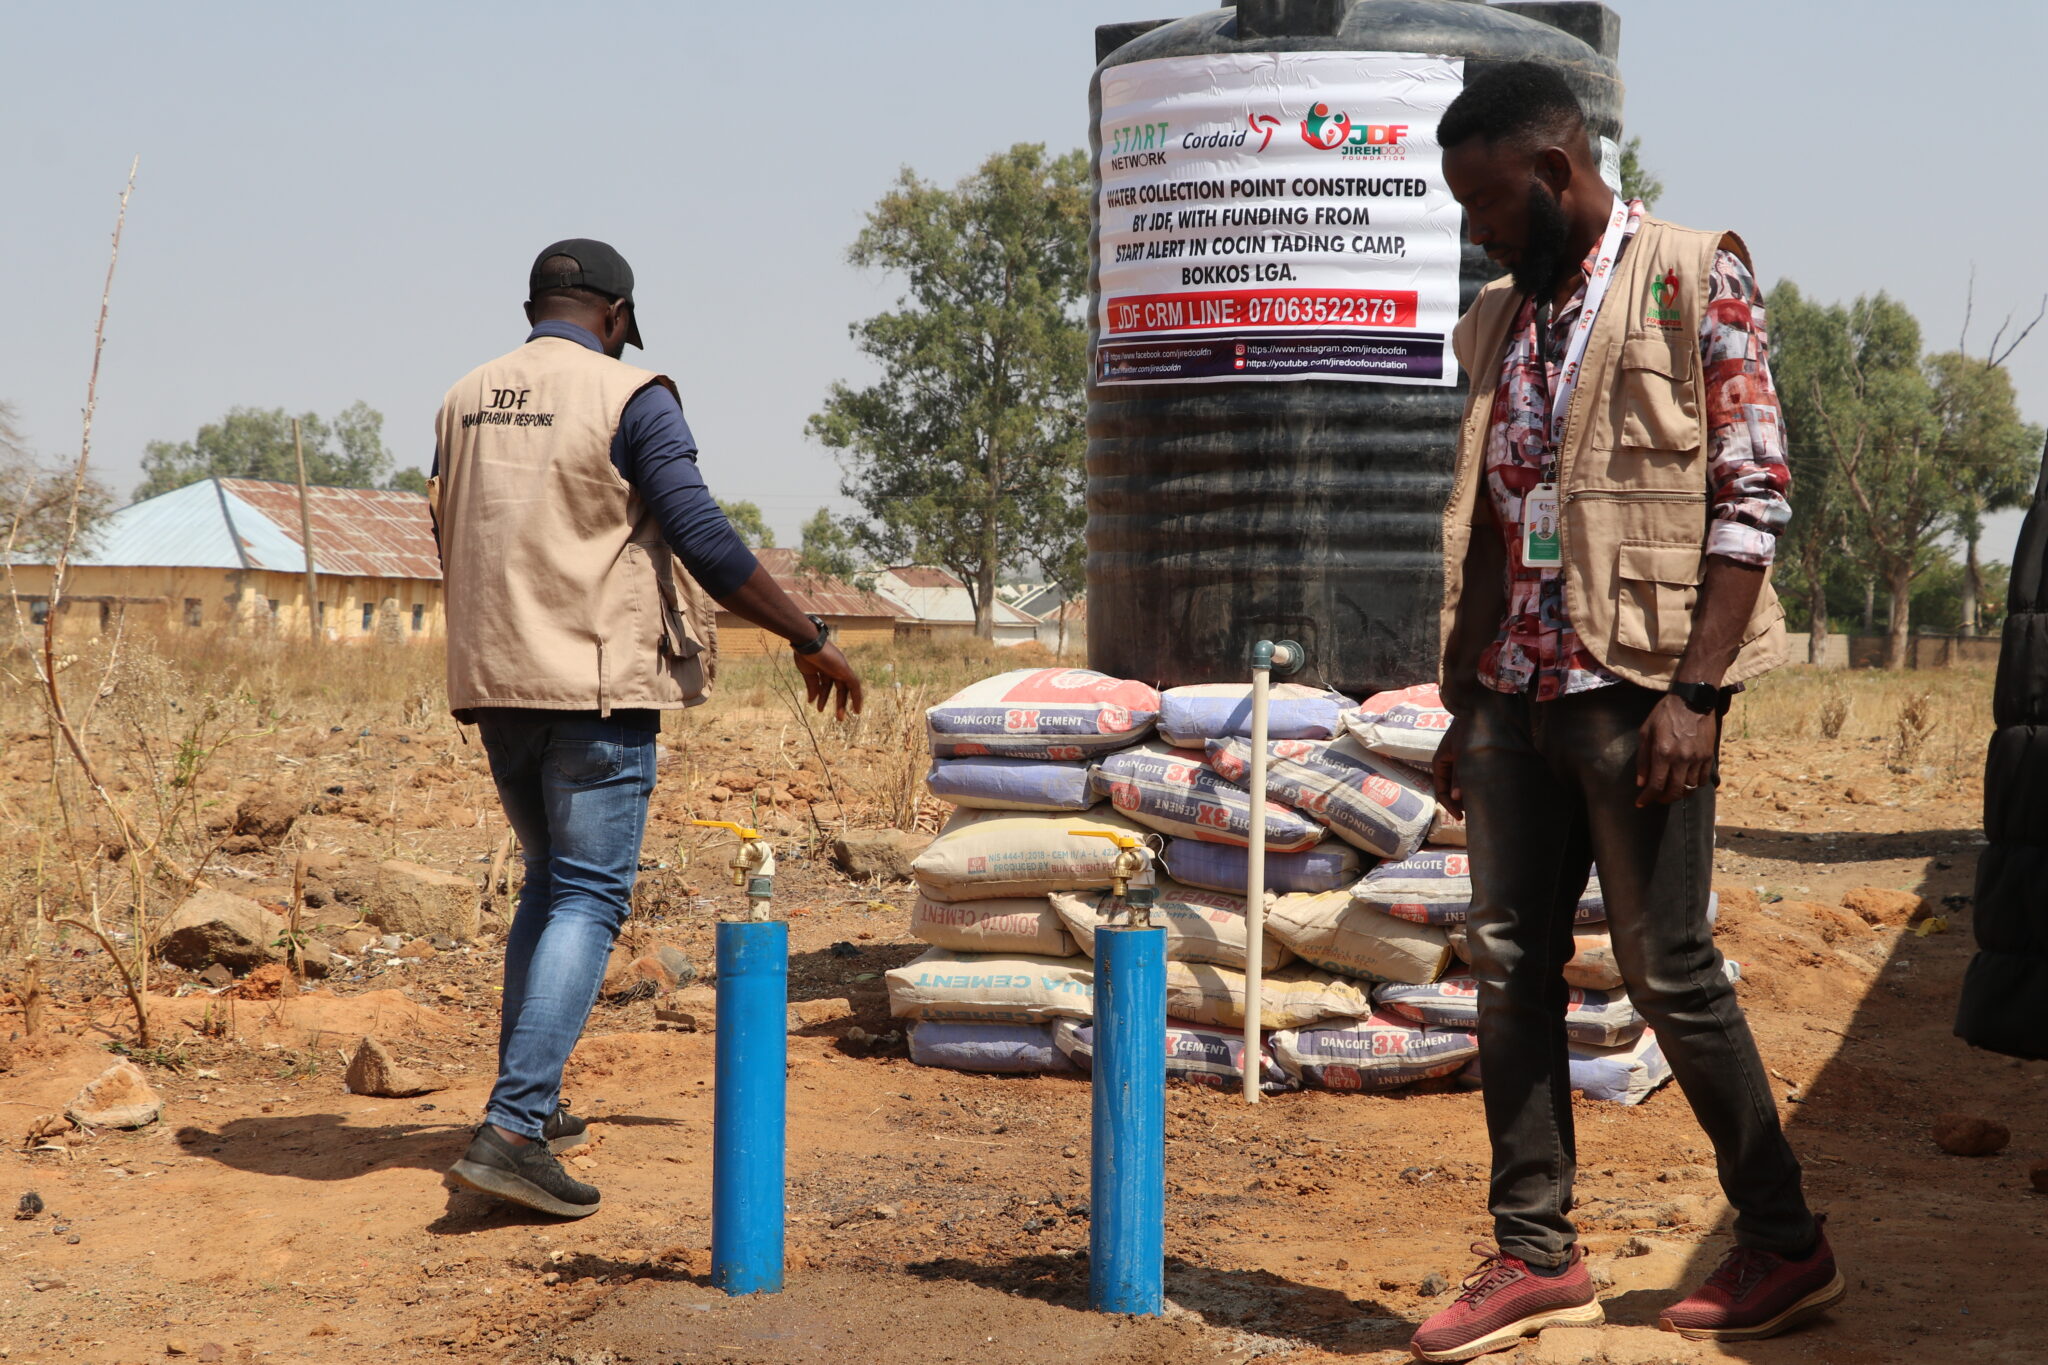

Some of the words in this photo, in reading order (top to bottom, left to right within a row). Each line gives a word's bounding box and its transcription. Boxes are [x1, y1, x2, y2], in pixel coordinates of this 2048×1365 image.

[1112, 121, 1169, 155] START
[1182, 129, 1248, 150] Cordaid
[1348, 124, 1409, 145] JDF
[1111, 151, 1167, 171] NETWORK
[1107, 187, 1138, 210] WATER
[1139, 180, 1225, 204] COLLECTION
[1231, 178, 1286, 199] POINT
[1292, 178, 1427, 198] CONSTRUCTED
[1132, 213, 1149, 233] BY
[1149, 211, 1174, 234] JDF,
[1178, 209, 1217, 230] WITH
[1222, 207, 1309, 227] FUNDING
[1315, 206, 1370, 226] FROM
[1115, 242, 1145, 263] START
[1146, 239, 1186, 260] ALERT
[1189, 237, 1207, 257] IN
[1211, 235, 1266, 255] COCIN
[1269, 234, 1346, 254] TADING
[1351, 234, 1407, 258] CAMP,
[1182, 264, 1250, 286] BOKKOS
[1255, 263, 1297, 282] LGA.
[1117, 305, 1141, 330] JDF
[1144, 302, 1182, 328] CRM
[1189, 299, 1241, 326] LINE:
[1248, 297, 1396, 324] 07063522379
[485, 389, 531, 410] JDF
[513, 413, 554, 427] RESPONSE
[953, 714, 1002, 725] DANGOTE
[1006, 710, 1039, 730] 3X
[1039, 716, 1084, 726] CEMENT
[1415, 713, 1452, 729] 3X
[1310, 751, 1352, 776] CEMENT
[1117, 760, 1165, 775] DANGOTE
[1166, 764, 1202, 790] 3X
[1154, 799, 1196, 817] CEMENT
[1294, 788, 1329, 813] 3X
[1195, 804, 1230, 828] 3X
[1328, 805, 1375, 836] DANGOTE
[993, 863, 1038, 873] PRODUCED
[1069, 863, 1101, 873] CEMENT
[921, 903, 976, 928] CEMENT
[913, 972, 1032, 989] CEMENT
[1179, 1040, 1227, 1056] CEMENT
[1320, 1036, 1371, 1052] DANGOTE
[1371, 1034, 1408, 1056] 3X
[1408, 1034, 1454, 1050] CEMENT
